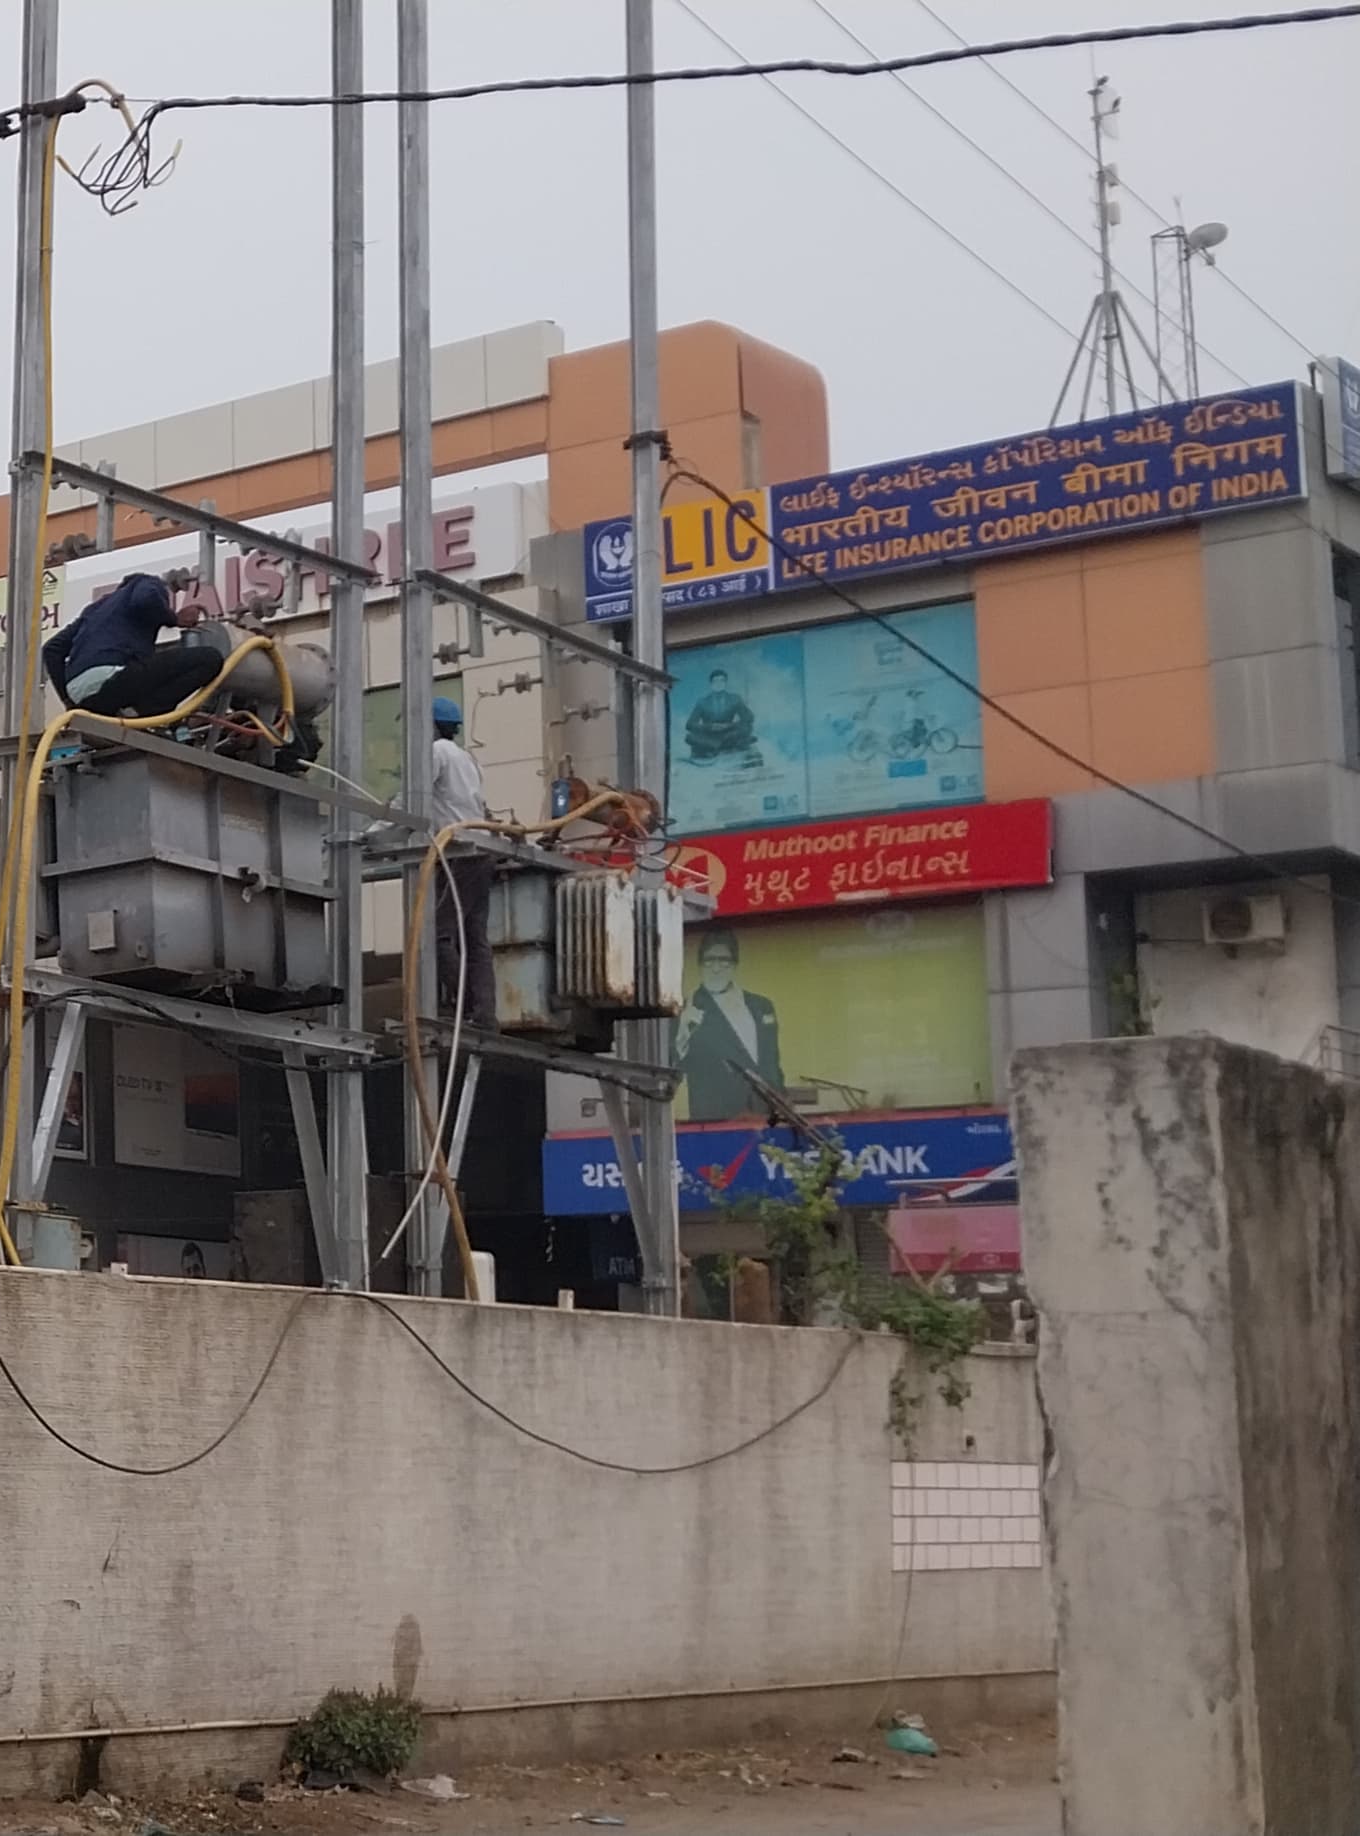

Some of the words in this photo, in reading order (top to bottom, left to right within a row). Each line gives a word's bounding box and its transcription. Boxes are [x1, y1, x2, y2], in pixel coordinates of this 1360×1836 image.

[781, 505, 911, 546] भारतीय
[931, 481, 1039, 518] जीवन
[1060, 460, 1150, 495] बीमा
[1171, 434, 1287, 476] निगम
[663, 500, 757, 575] LIC
[782, 552, 828, 579] LIFE
[835, 525, 972, 569] INSURANCE
[977, 490, 1160, 543] CORPORATION
[1168, 483, 1203, 510] OF
[1212, 468, 1288, 499] INDIA
[744, 829, 858, 862] Muthoot
[864, 820, 969, 848] Finance
[744, 866, 811, 905] મુથૂટ
[829, 849, 970, 892] ફાઈનાન્સ
[836, 1144, 930, 1177] BANK
